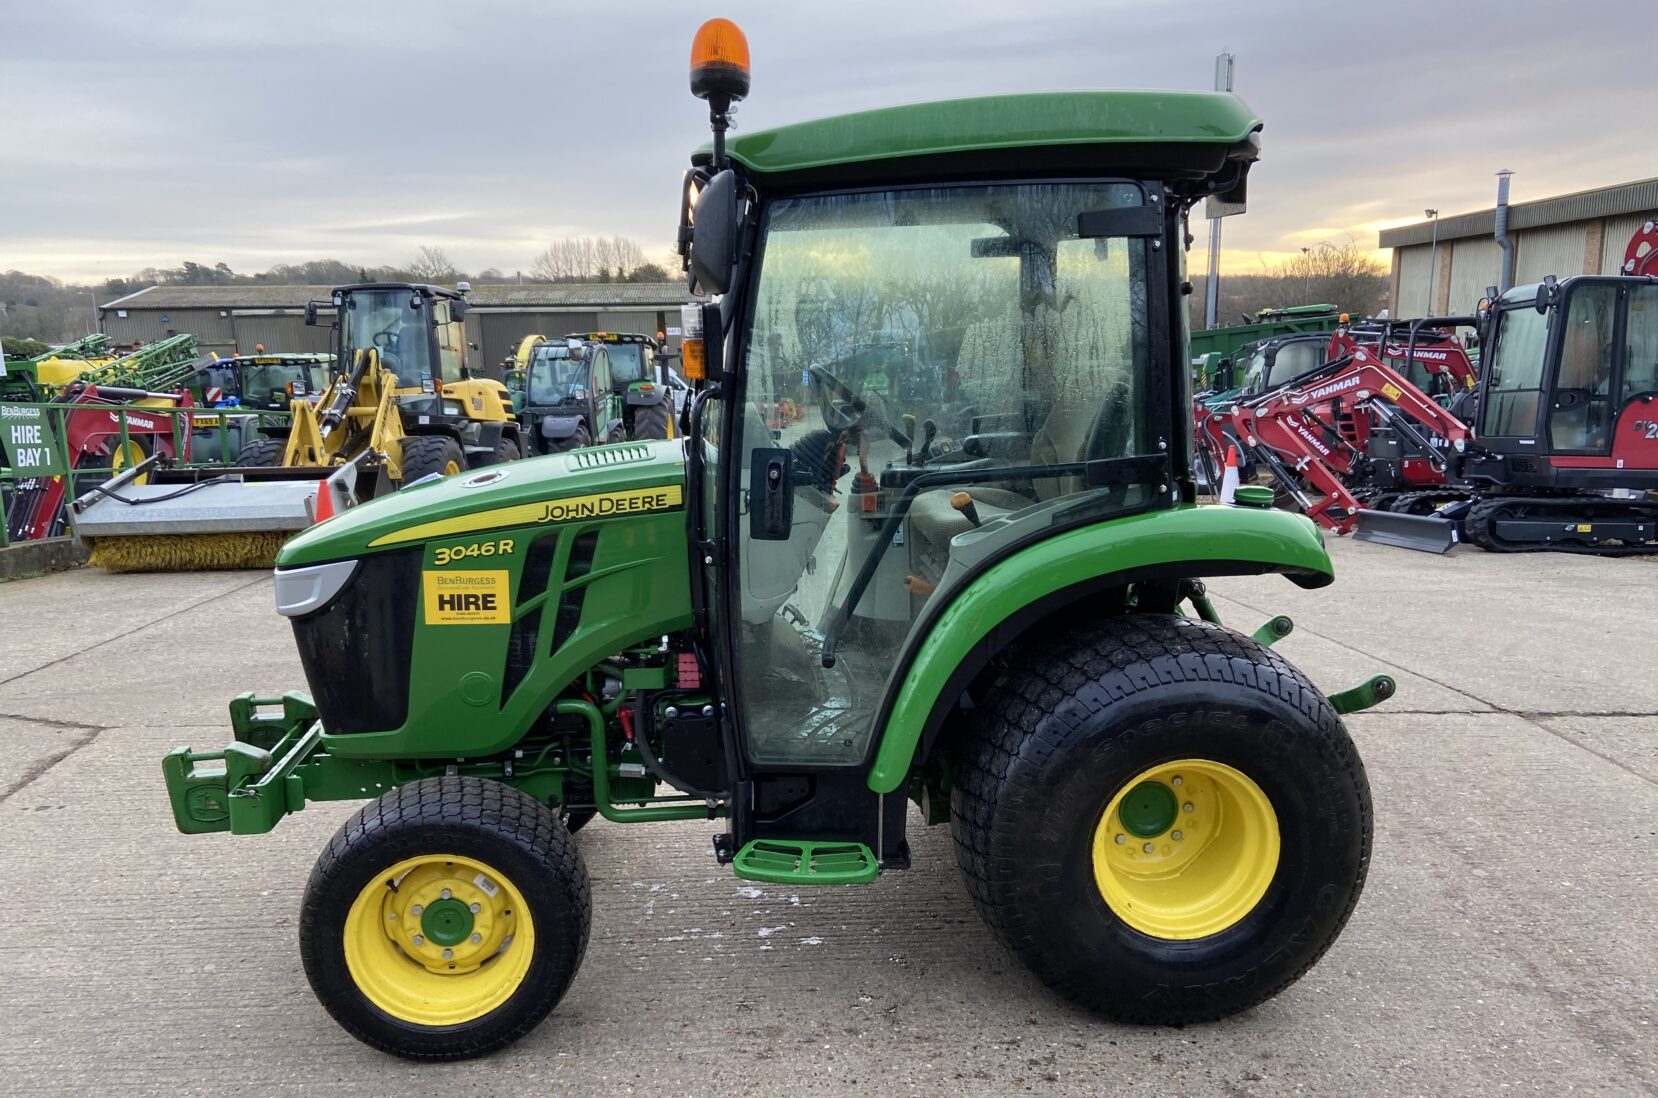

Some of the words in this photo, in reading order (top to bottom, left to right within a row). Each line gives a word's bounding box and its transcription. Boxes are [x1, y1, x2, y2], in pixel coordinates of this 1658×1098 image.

[1310, 376, 1360, 399] YANMAR
[126, 415, 153, 430] ANMAR
[11, 425, 42, 444] HIRE
[1297, 425, 1331, 456] YANMAR
[16, 447, 41, 467] BAY
[44, 447, 52, 466] 1
[538, 502, 595, 522] JOHN
[598, 493, 668, 515] DEERE
[438, 593, 497, 611] HIRE
